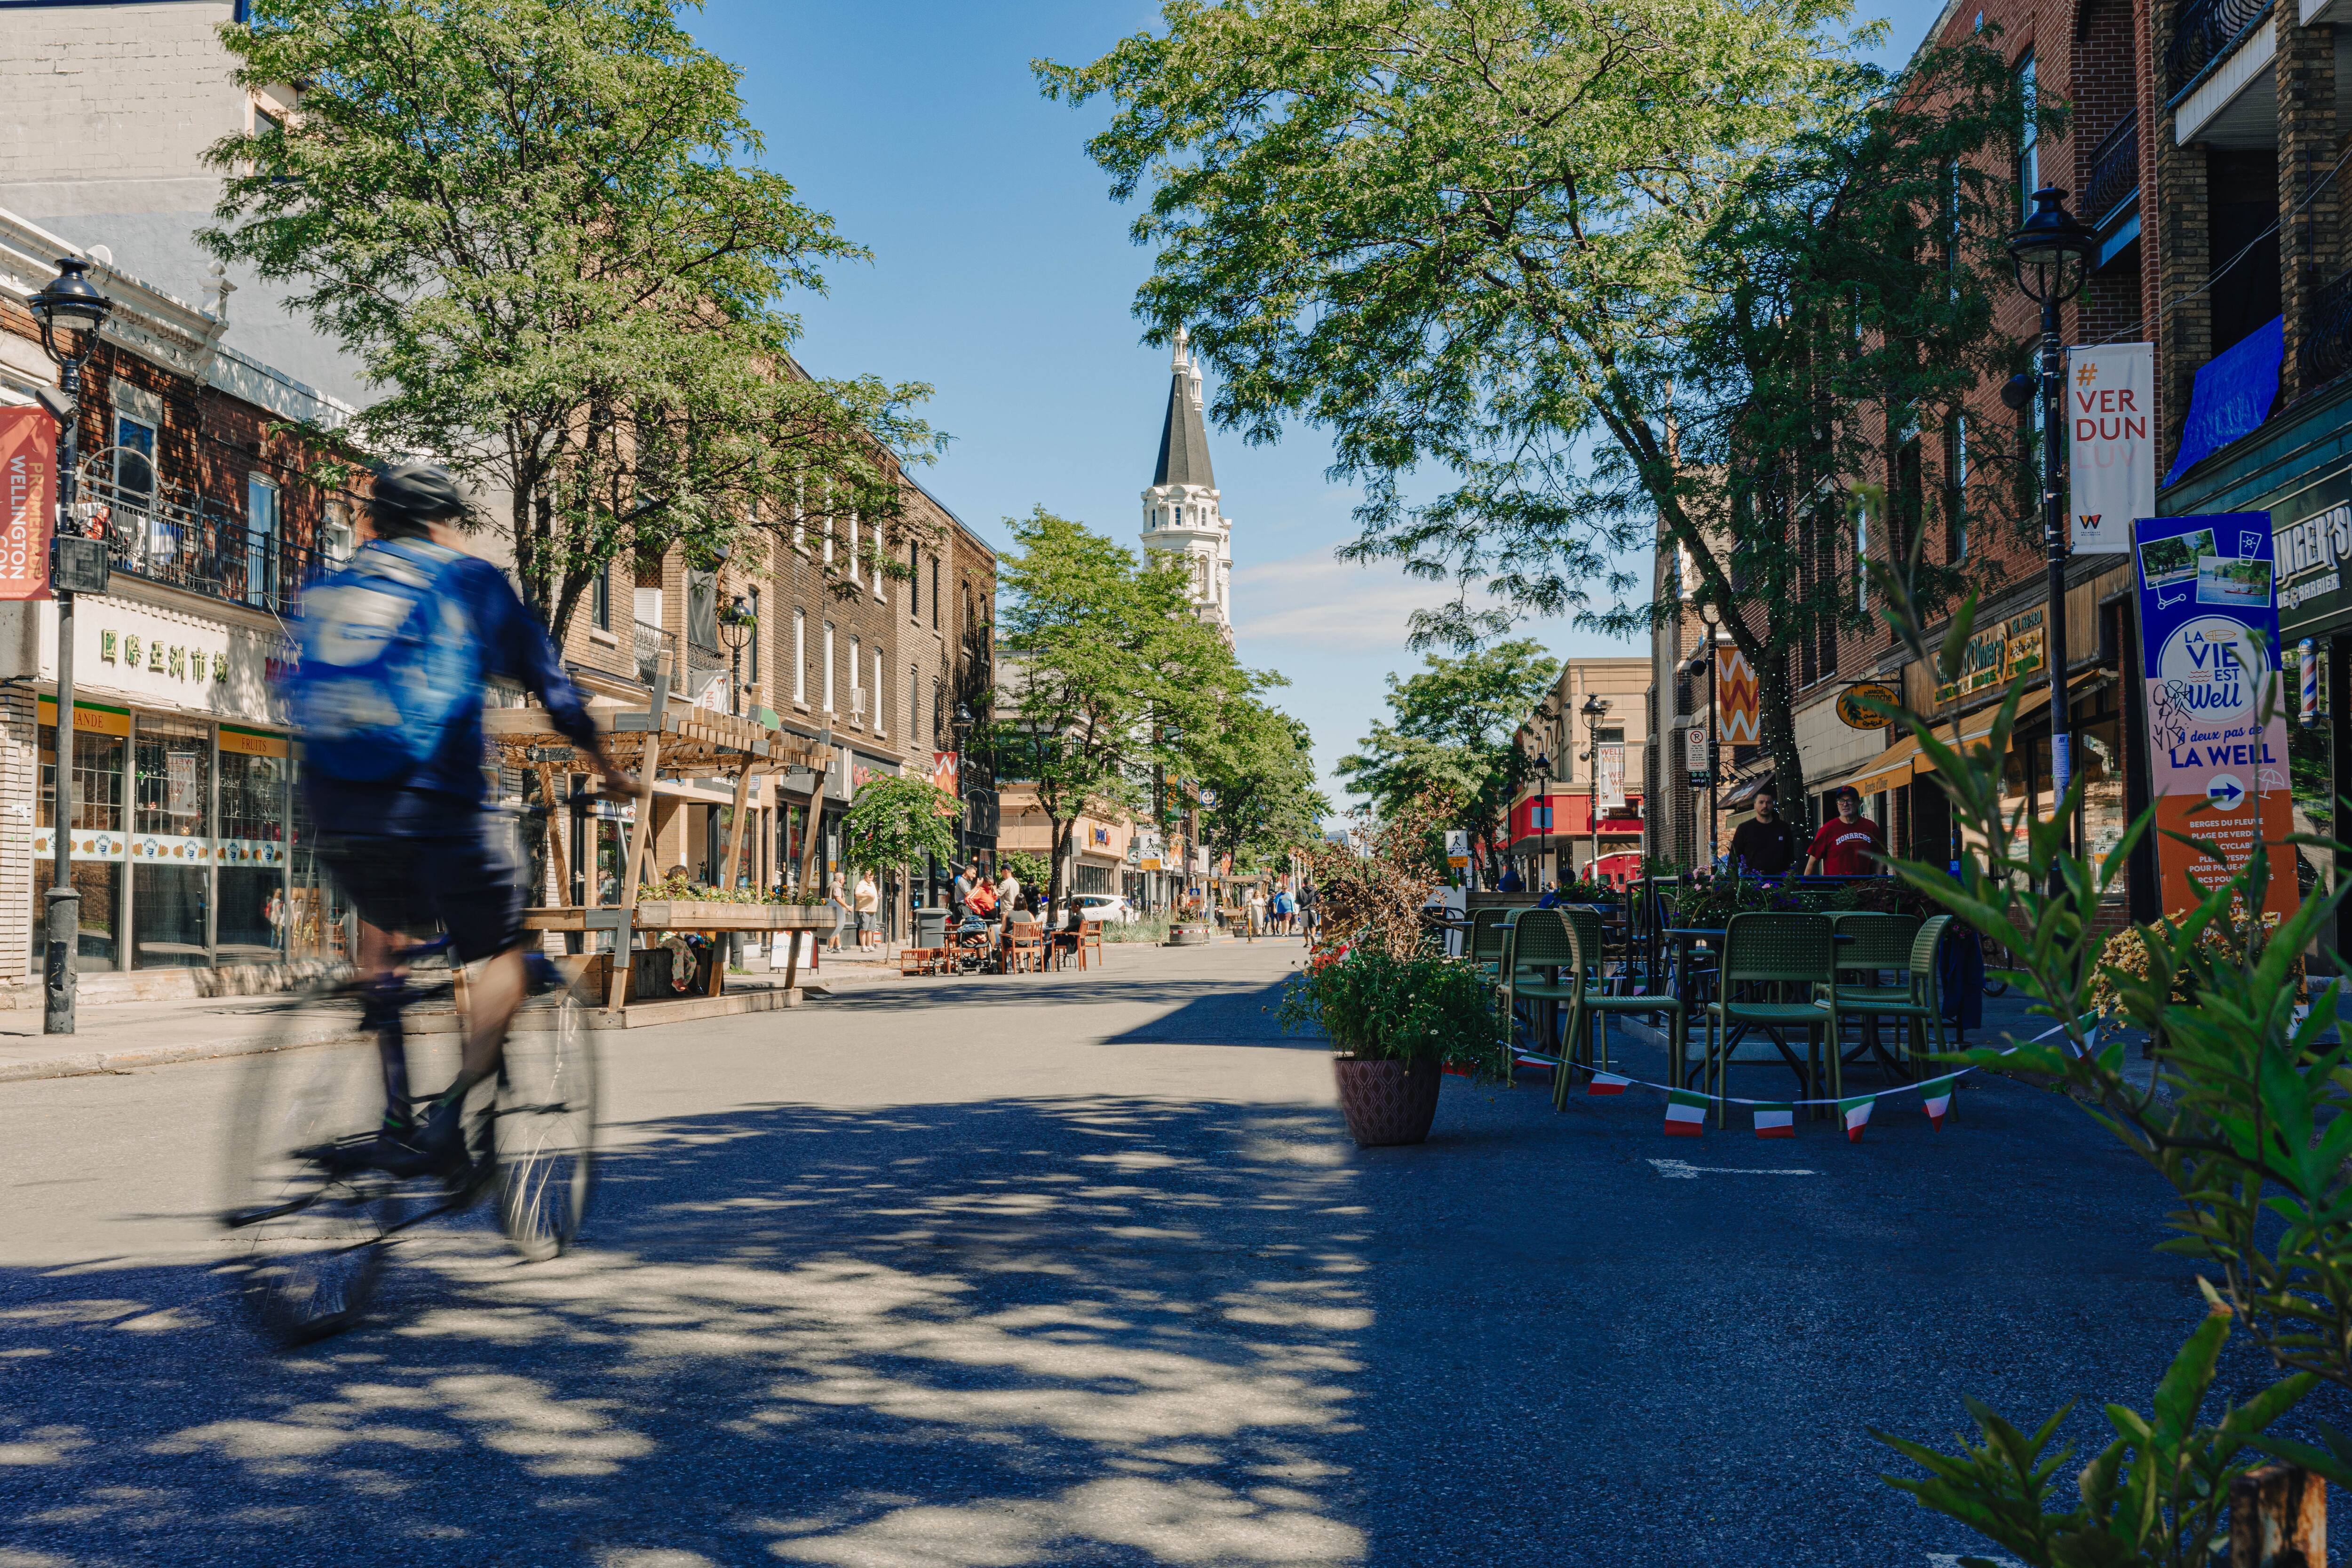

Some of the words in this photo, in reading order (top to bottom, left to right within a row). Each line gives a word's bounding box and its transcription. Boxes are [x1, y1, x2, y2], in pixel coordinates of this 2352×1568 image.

[2076, 363, 2098, 386] #
[2076, 389, 2138, 414] VER
[2076, 416, 2145, 441] DUN
[2077, 444, 2137, 469] LUV
[10, 455, 26, 579] WELLINGTON
[27, 462, 44, 579] PROMENADE
[2273, 507, 2349, 579] INGER'S
[2298, 573, 2341, 602] BARBIER
[2185, 631, 2204, 643] LA
[2186, 642, 2239, 669] VIE
[2215, 669, 2240, 681] EST
[2189, 683, 2242, 709] Well
[73, 711, 103, 728] IANDE
[241, 737, 267, 752] FRUITS
[2191, 731, 2220, 742] deux
[2224, 727, 2245, 743] pas
[2170, 747, 2203, 768] LA
[2207, 744, 2276, 766] WELL
[1836, 832, 1871, 845] MONARCHS
